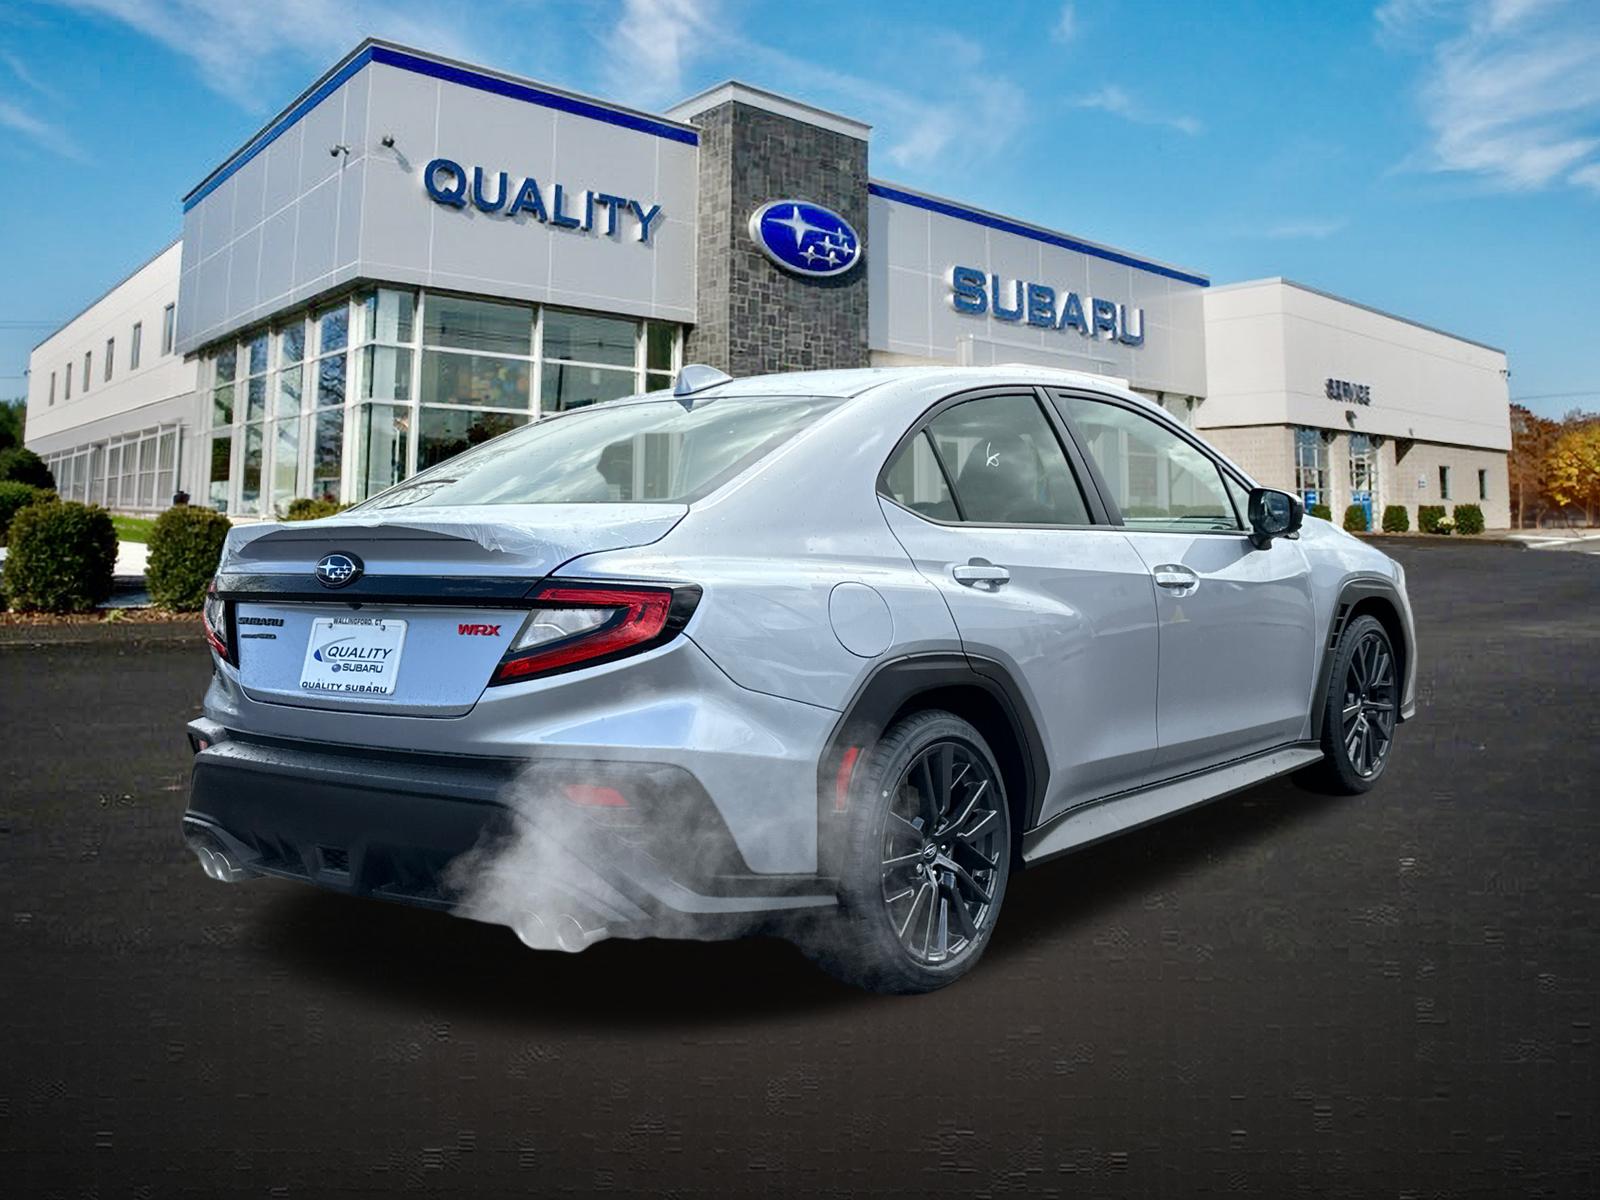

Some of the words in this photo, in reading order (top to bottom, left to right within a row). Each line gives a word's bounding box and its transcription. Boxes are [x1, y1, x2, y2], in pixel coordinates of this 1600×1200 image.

[424, 158, 661, 242] QUALITY
[949, 265, 1145, 347] SUBARU
[238, 616, 285, 627] SUBARU
[458, 624, 502, 636] WRX
[327, 646, 393, 660] QUALITY
[342, 663, 384, 674] SUBARU
[301, 681, 342, 692] QUALITY
[345, 684, 387, 694] SUBARU
